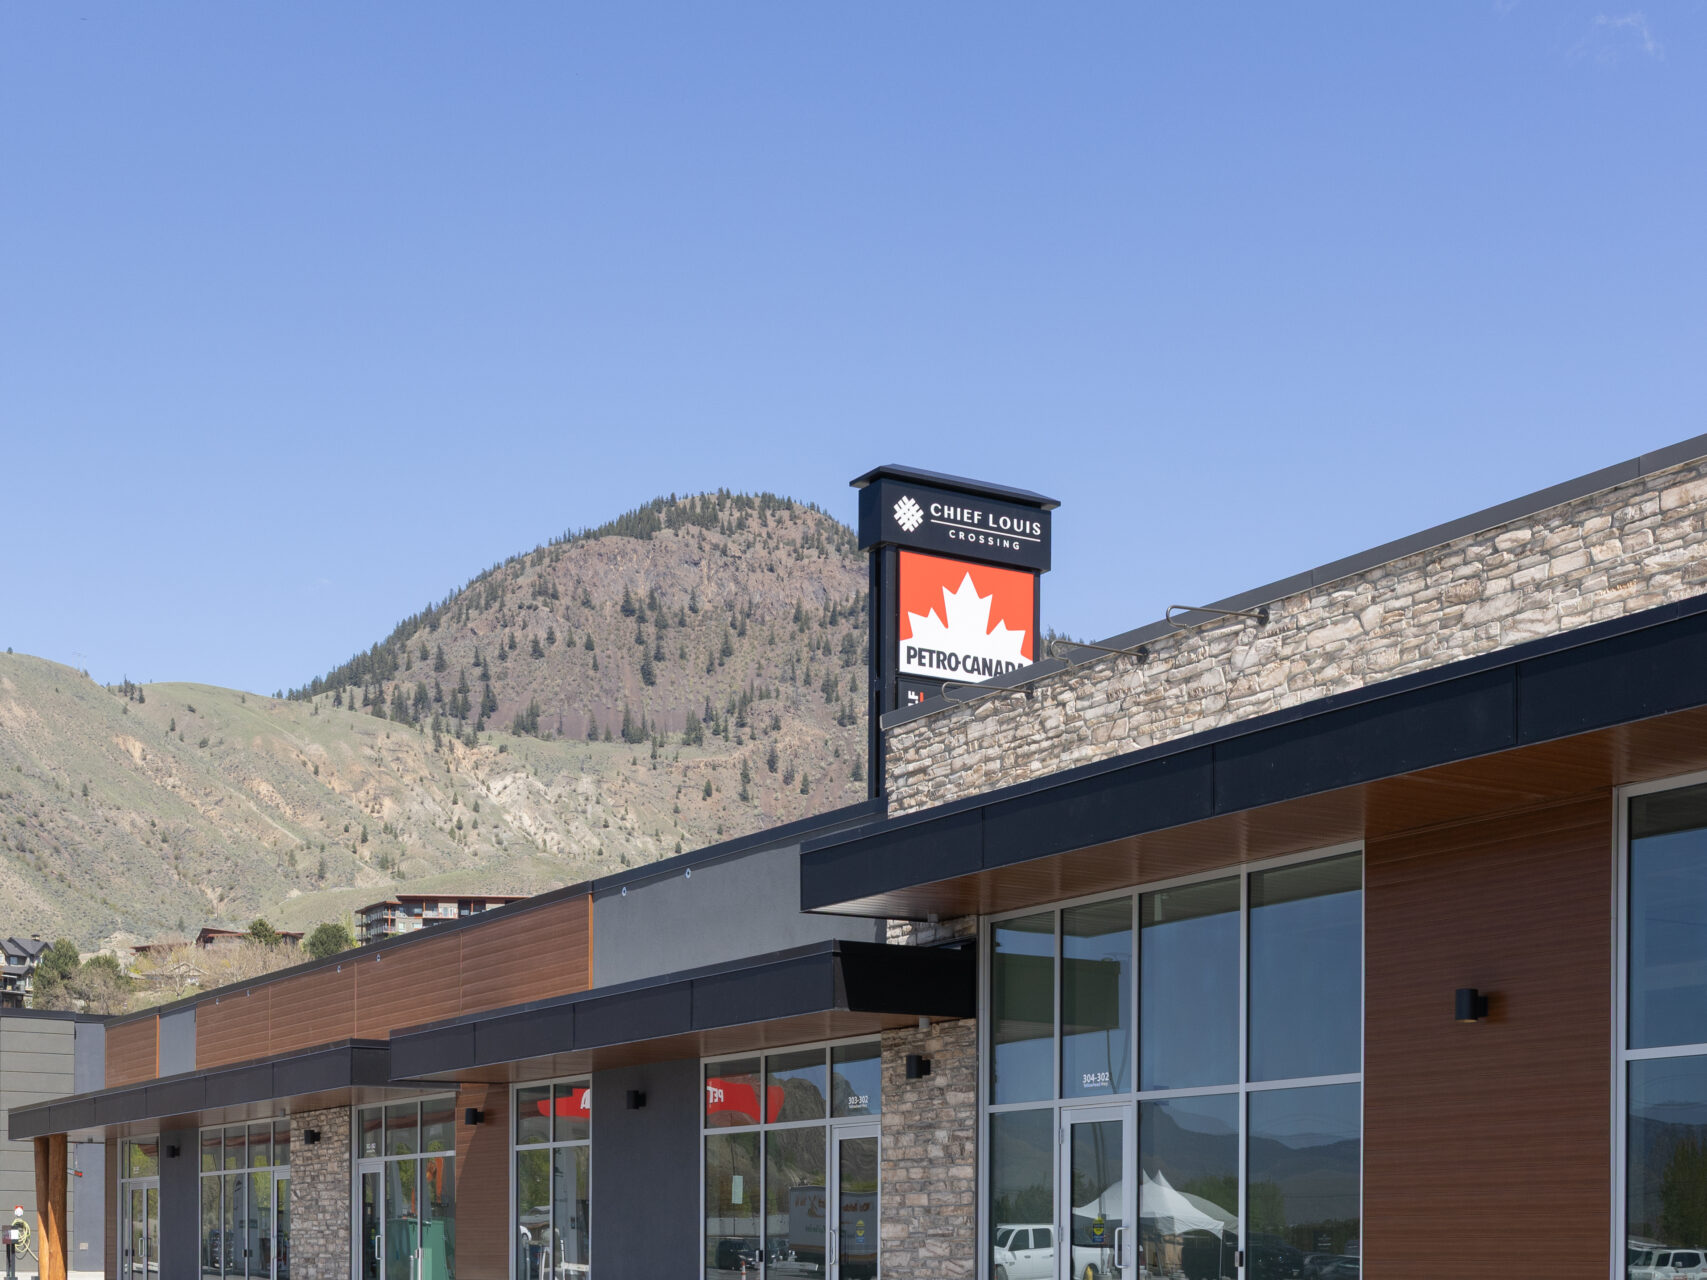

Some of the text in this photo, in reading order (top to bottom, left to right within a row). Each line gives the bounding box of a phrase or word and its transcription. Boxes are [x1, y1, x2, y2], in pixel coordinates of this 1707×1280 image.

[930, 503, 1041, 535] CHIEF LOUIS
[948, 529, 1020, 550] CROSSING
[906, 645, 1024, 677] PETRO-CANAD
[1082, 1071, 1110, 1083] 304-302
